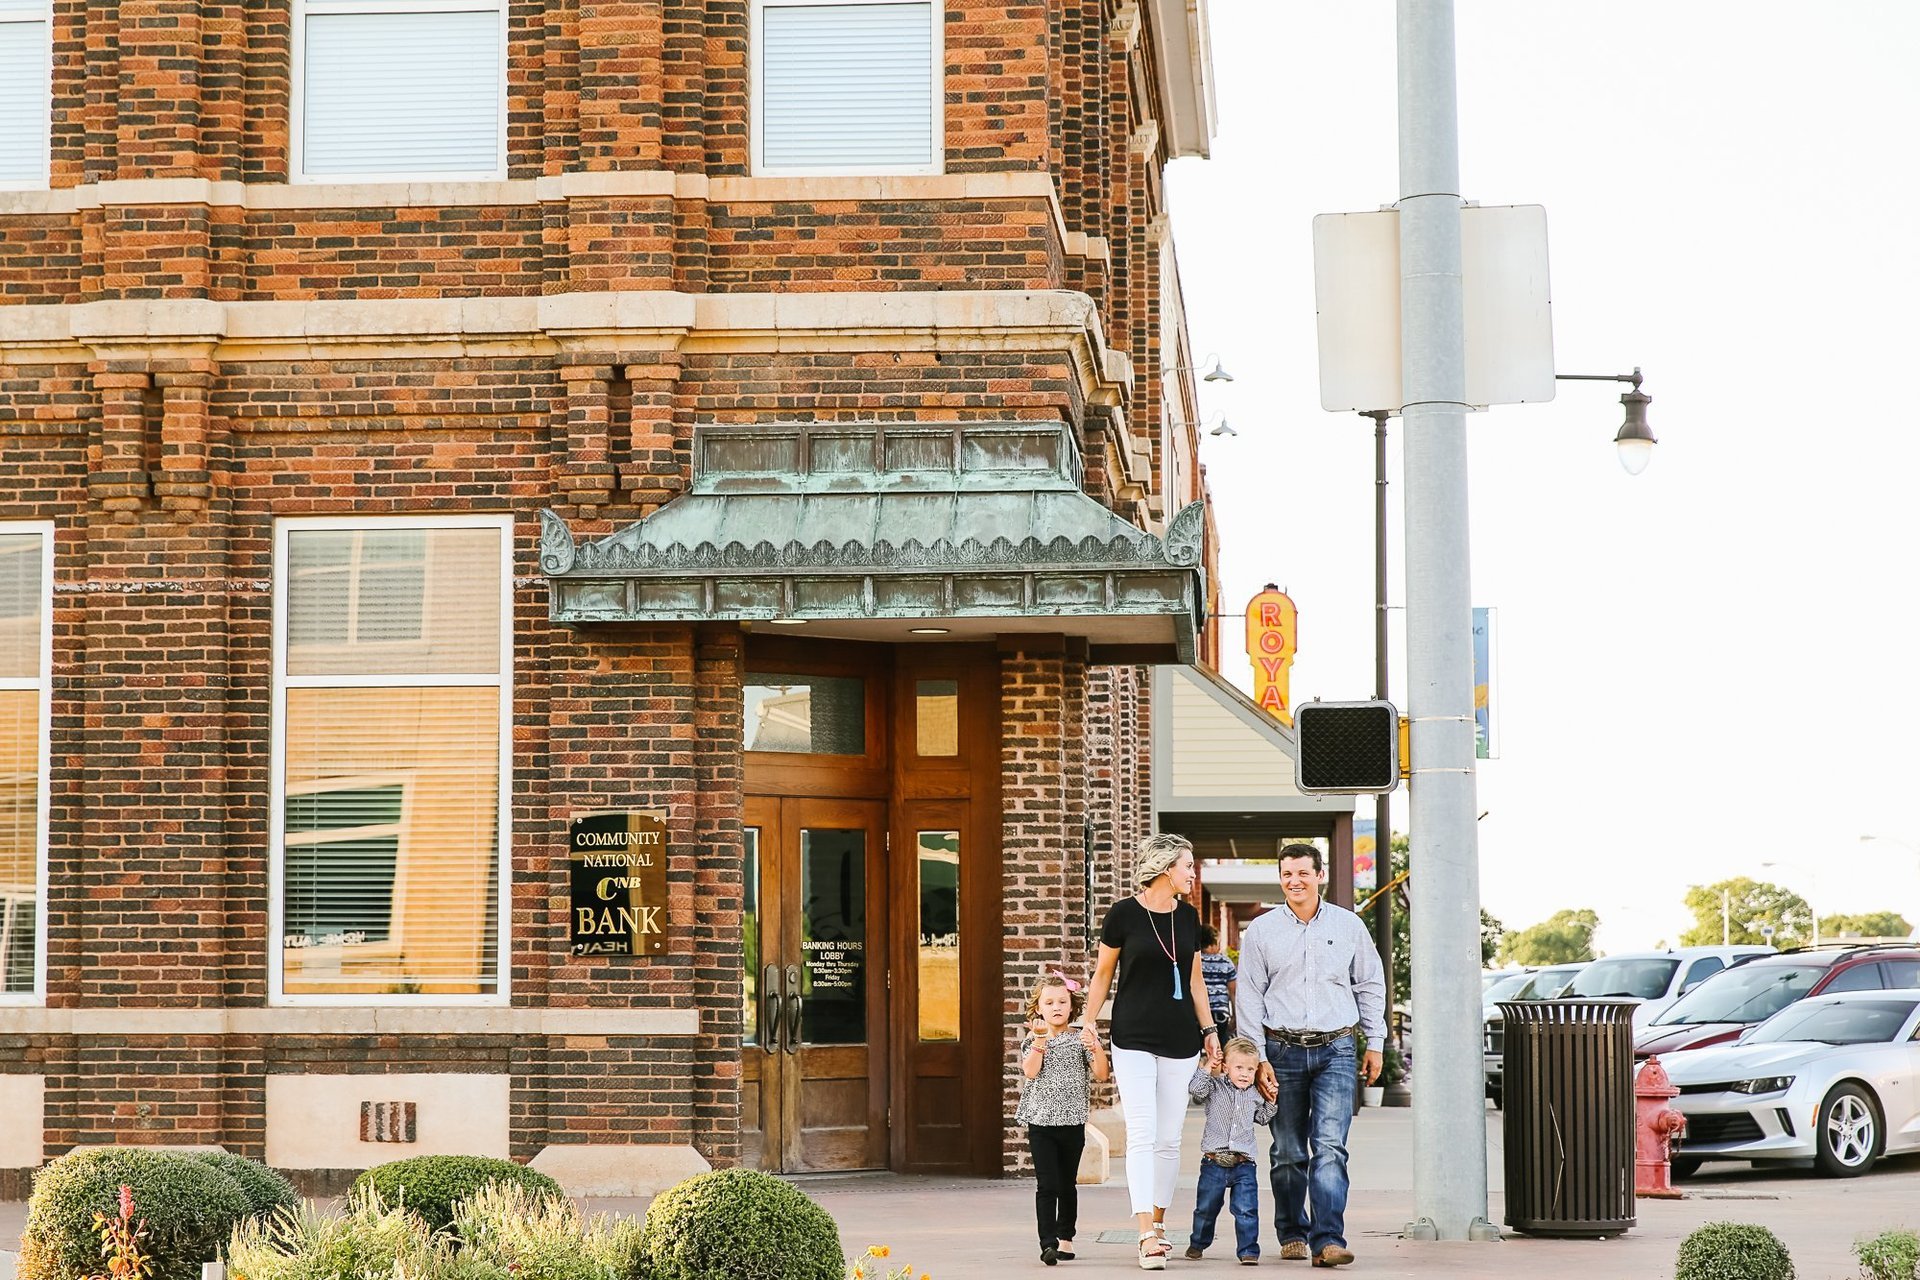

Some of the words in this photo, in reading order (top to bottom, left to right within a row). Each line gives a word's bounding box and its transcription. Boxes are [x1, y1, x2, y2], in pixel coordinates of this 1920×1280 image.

[576, 831, 660, 846] COMMUNITY
[583, 853, 654, 867] NATIONAL
[576, 906, 662, 934] BANK
[802, 941, 835, 950] BANKING
[836, 941, 863, 950] HOURS
[820, 951, 845, 960] LOBBY
[837, 960, 859, 968] Thursday
